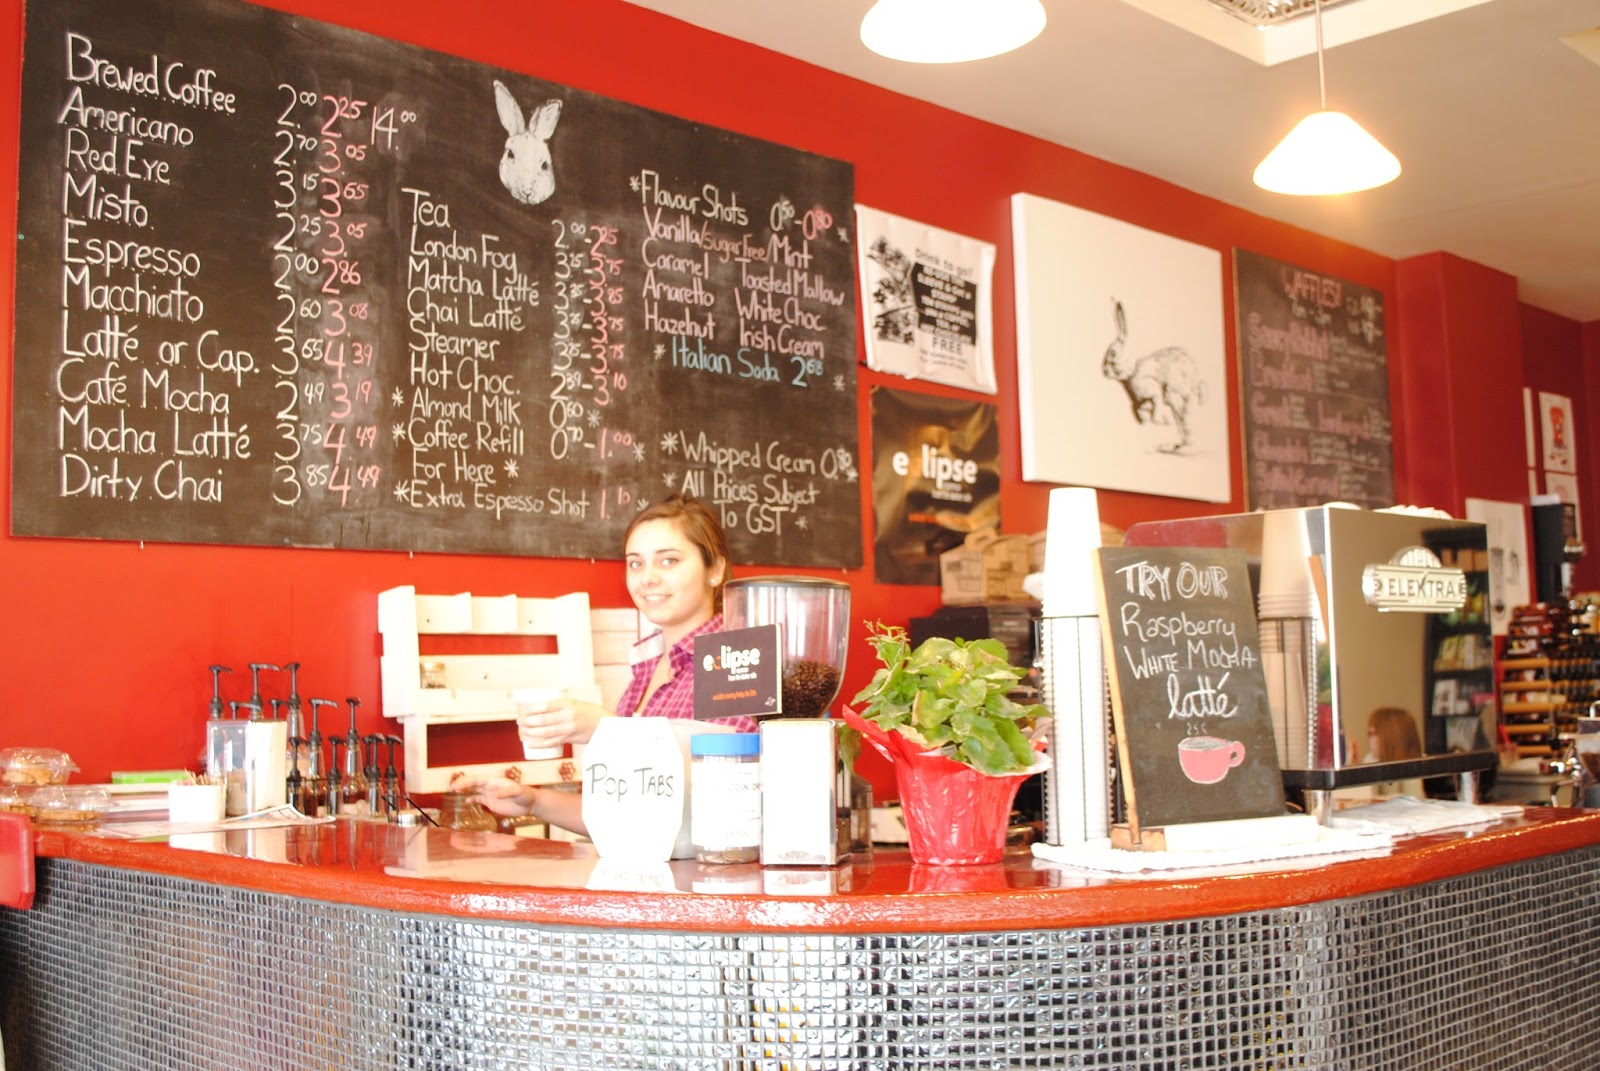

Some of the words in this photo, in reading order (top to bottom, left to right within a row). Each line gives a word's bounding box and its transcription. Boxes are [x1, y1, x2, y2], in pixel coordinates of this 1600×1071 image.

[66, 32, 159, 95] Brewed
[165, 62, 236, 114] Coffee
[59, 86, 194, 147] Americano
[65, 128, 117, 174] Red
[124, 140, 171, 185] Eye
[401, 188, 451, 228] Tea
[642, 169, 700, 215] Flavour
[702, 184, 749, 226] Shots
[63, 218, 200, 279] Espresso
[410, 224, 477, 264] London
[482, 234, 518, 284] Fog
[642, 237, 709, 280] Caramel
[63, 265, 204, 322] Macchiato
[408, 256, 484, 296] Matcha
[492, 269, 539, 306] Latté
[642, 270, 714, 307] Amaretto
[734, 257, 792, 296] Toasted
[406, 286, 458, 325] Chai
[469, 295, 525, 332] Latté
[645, 299, 716, 341] Hazelnut
[734, 287, 782, 325] White
[63, 308, 139, 360] Latté
[159, 341, 188, 365] or
[409, 317, 500, 361] Steamer
[740, 317, 775, 352] Irish
[778, 325, 824, 359] Cream
[932, 337, 962, 356] FREE
[411, 351, 453, 391] Hot
[672, 336, 731, 375] Italian
[737, 347, 780, 382] Soda
[56, 357, 128, 404] Café
[142, 368, 229, 415] Mocha
[410, 386, 472, 423] Almond
[482, 395, 521, 426] Milk
[59, 405, 156, 453] Mocha
[174, 411, 251, 459] Latté
[408, 417, 470, 450] Coffee
[477, 422, 524, 456] Refill
[680, 430, 761, 474] Whipped
[766, 441, 815, 475] Cream
[61, 454, 142, 502] Dirty
[154, 460, 222, 502] Chai
[413, 447, 446, 479] For
[454, 451, 496, 484] Here
[892, 443, 978, 489] elipse
[410, 479, 465, 509] Extra
[474, 483, 544, 521] Espresso
[548, 487, 590, 519] Shot
[682, 470, 705, 497] All
[713, 470, 758, 501] Prices
[763, 473, 821, 513] Subject
[713, 500, 738, 529] To
[746, 502, 790, 536] GST
[1115, 561, 1172, 601] TRY
[1176, 562, 1228, 600] OUR
[1388, 572, 1456, 599] ELEKTRA
[1121, 602, 1236, 655] Raspberry
[703, 645, 760, 674] eclipse
[1165, 671, 1239, 720] latté
